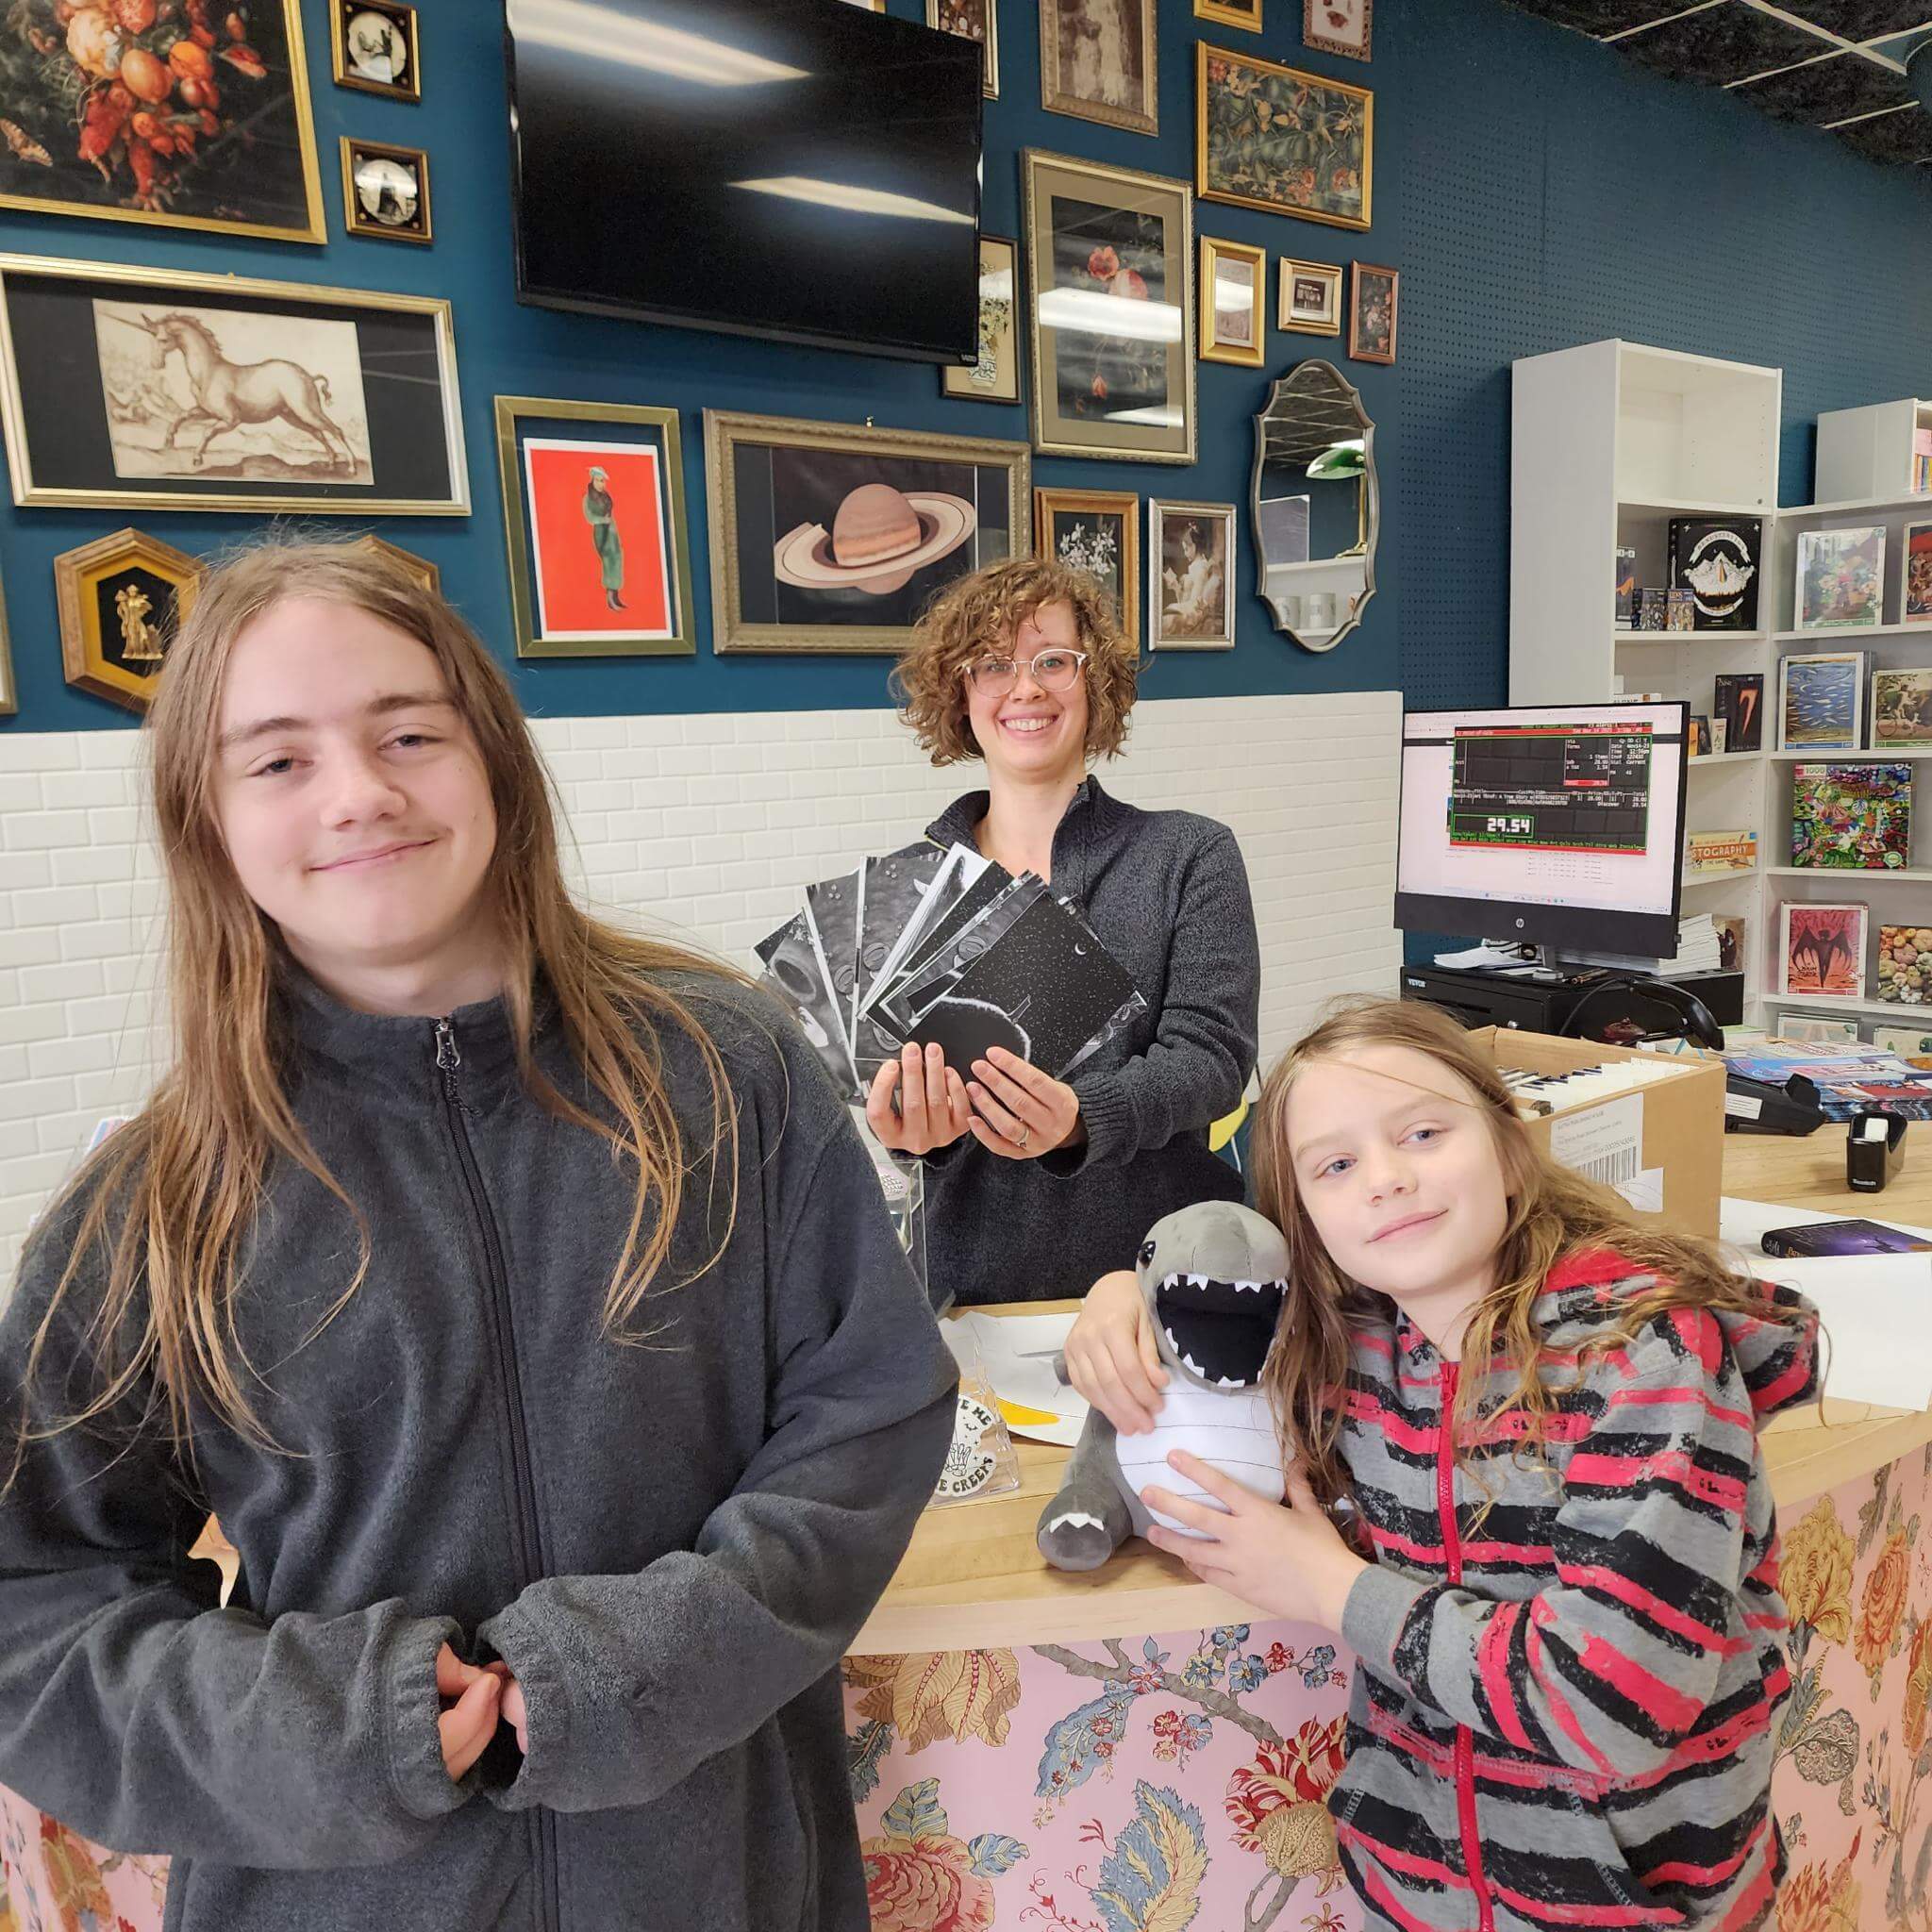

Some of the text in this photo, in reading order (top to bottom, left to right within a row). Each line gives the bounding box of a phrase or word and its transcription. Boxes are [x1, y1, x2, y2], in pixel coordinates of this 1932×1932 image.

[1487, 817, 1530, 833] 29.54
[972, 1407, 991, 1426] ME
[953, 1457, 993, 1492] CREEPS
